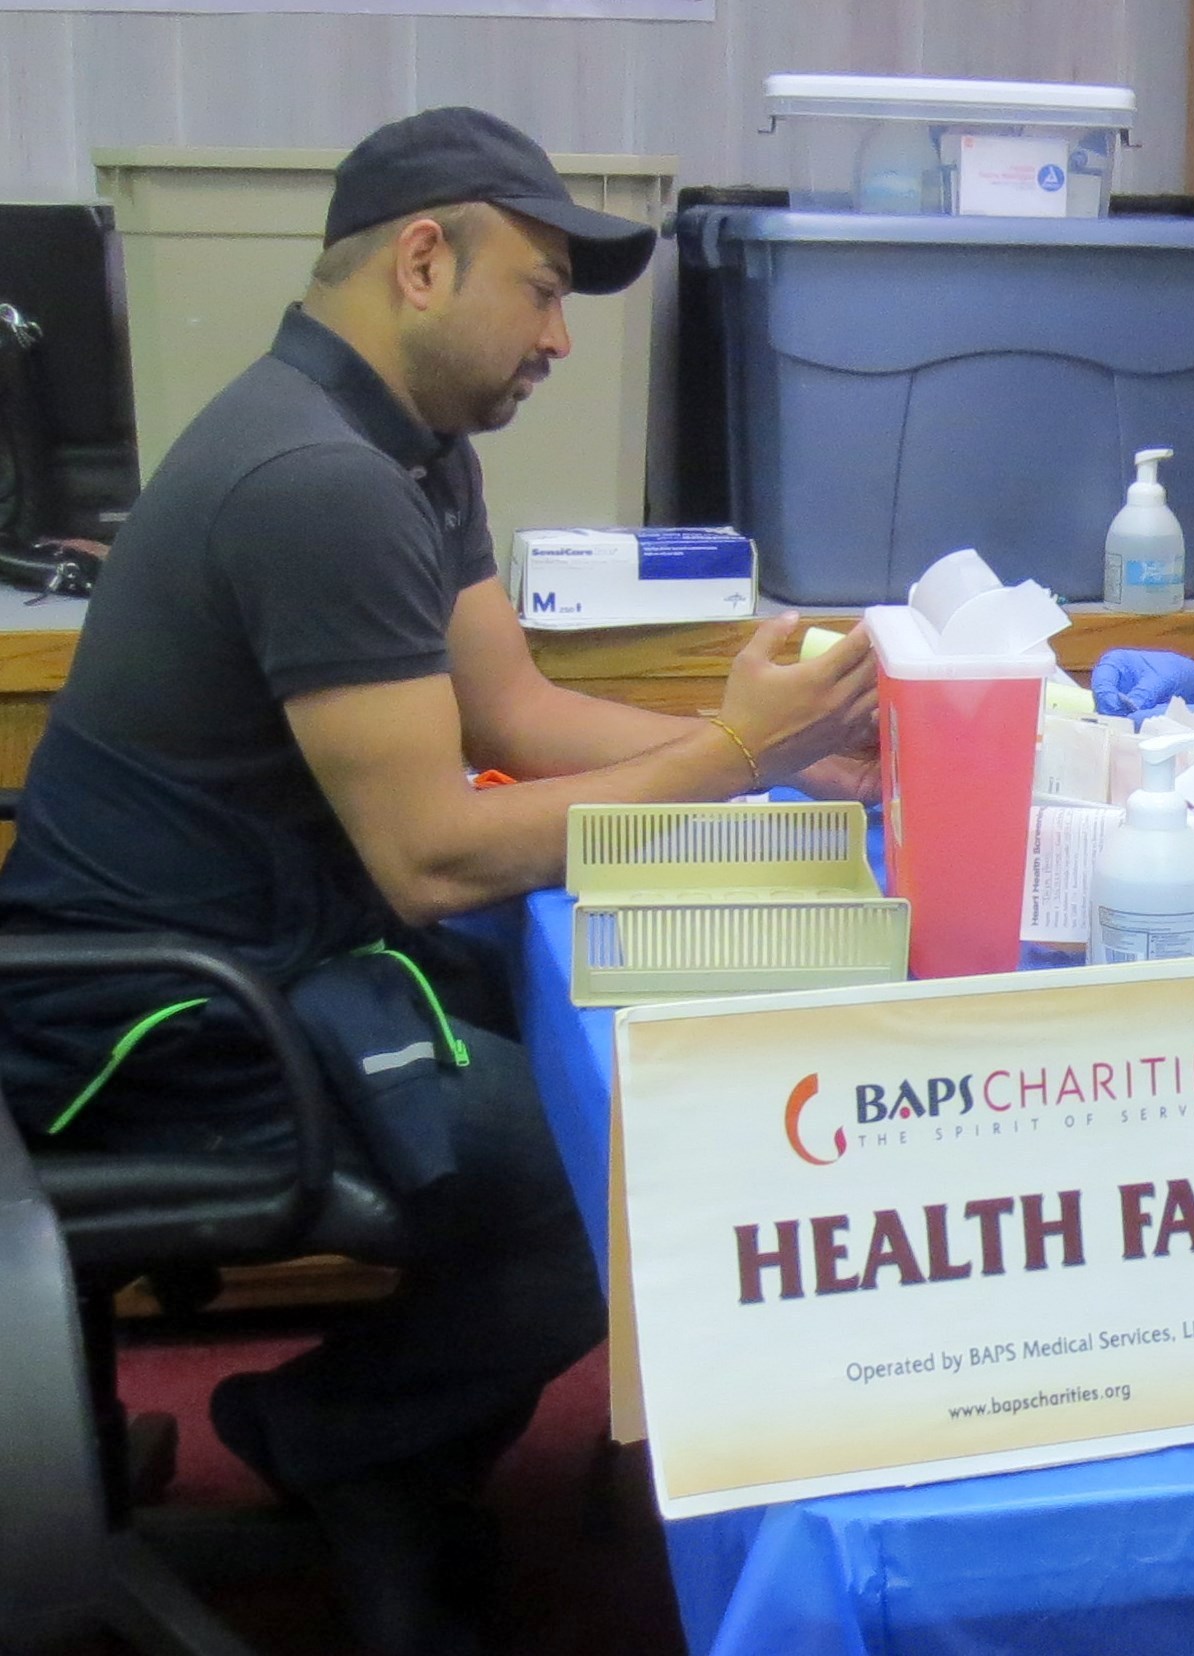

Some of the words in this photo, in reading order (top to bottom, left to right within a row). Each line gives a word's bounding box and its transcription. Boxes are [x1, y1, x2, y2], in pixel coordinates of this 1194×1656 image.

[532, 591, 556, 613] M
[1031, 857, 1041, 893] Health
[1030, 895, 1040, 926] Heart
[856, 1074, 973, 1124] BAPS
[857, 1130, 908, 1148] THE
[934, 1118, 1040, 1142] SPIRIT
[1064, 1113, 1095, 1129] OF
[733, 1189, 1086, 1305] HEALTH
[846, 1352, 935, 1384] Operated
[941, 1351, 964, 1374] by
[969, 1342, 1017, 1367] BAPS
[1022, 1333, 1093, 1360] Medical
[1099, 1323, 1176, 1350] Services,
[948, 1382, 1132, 1420] www.bapscharities.org
